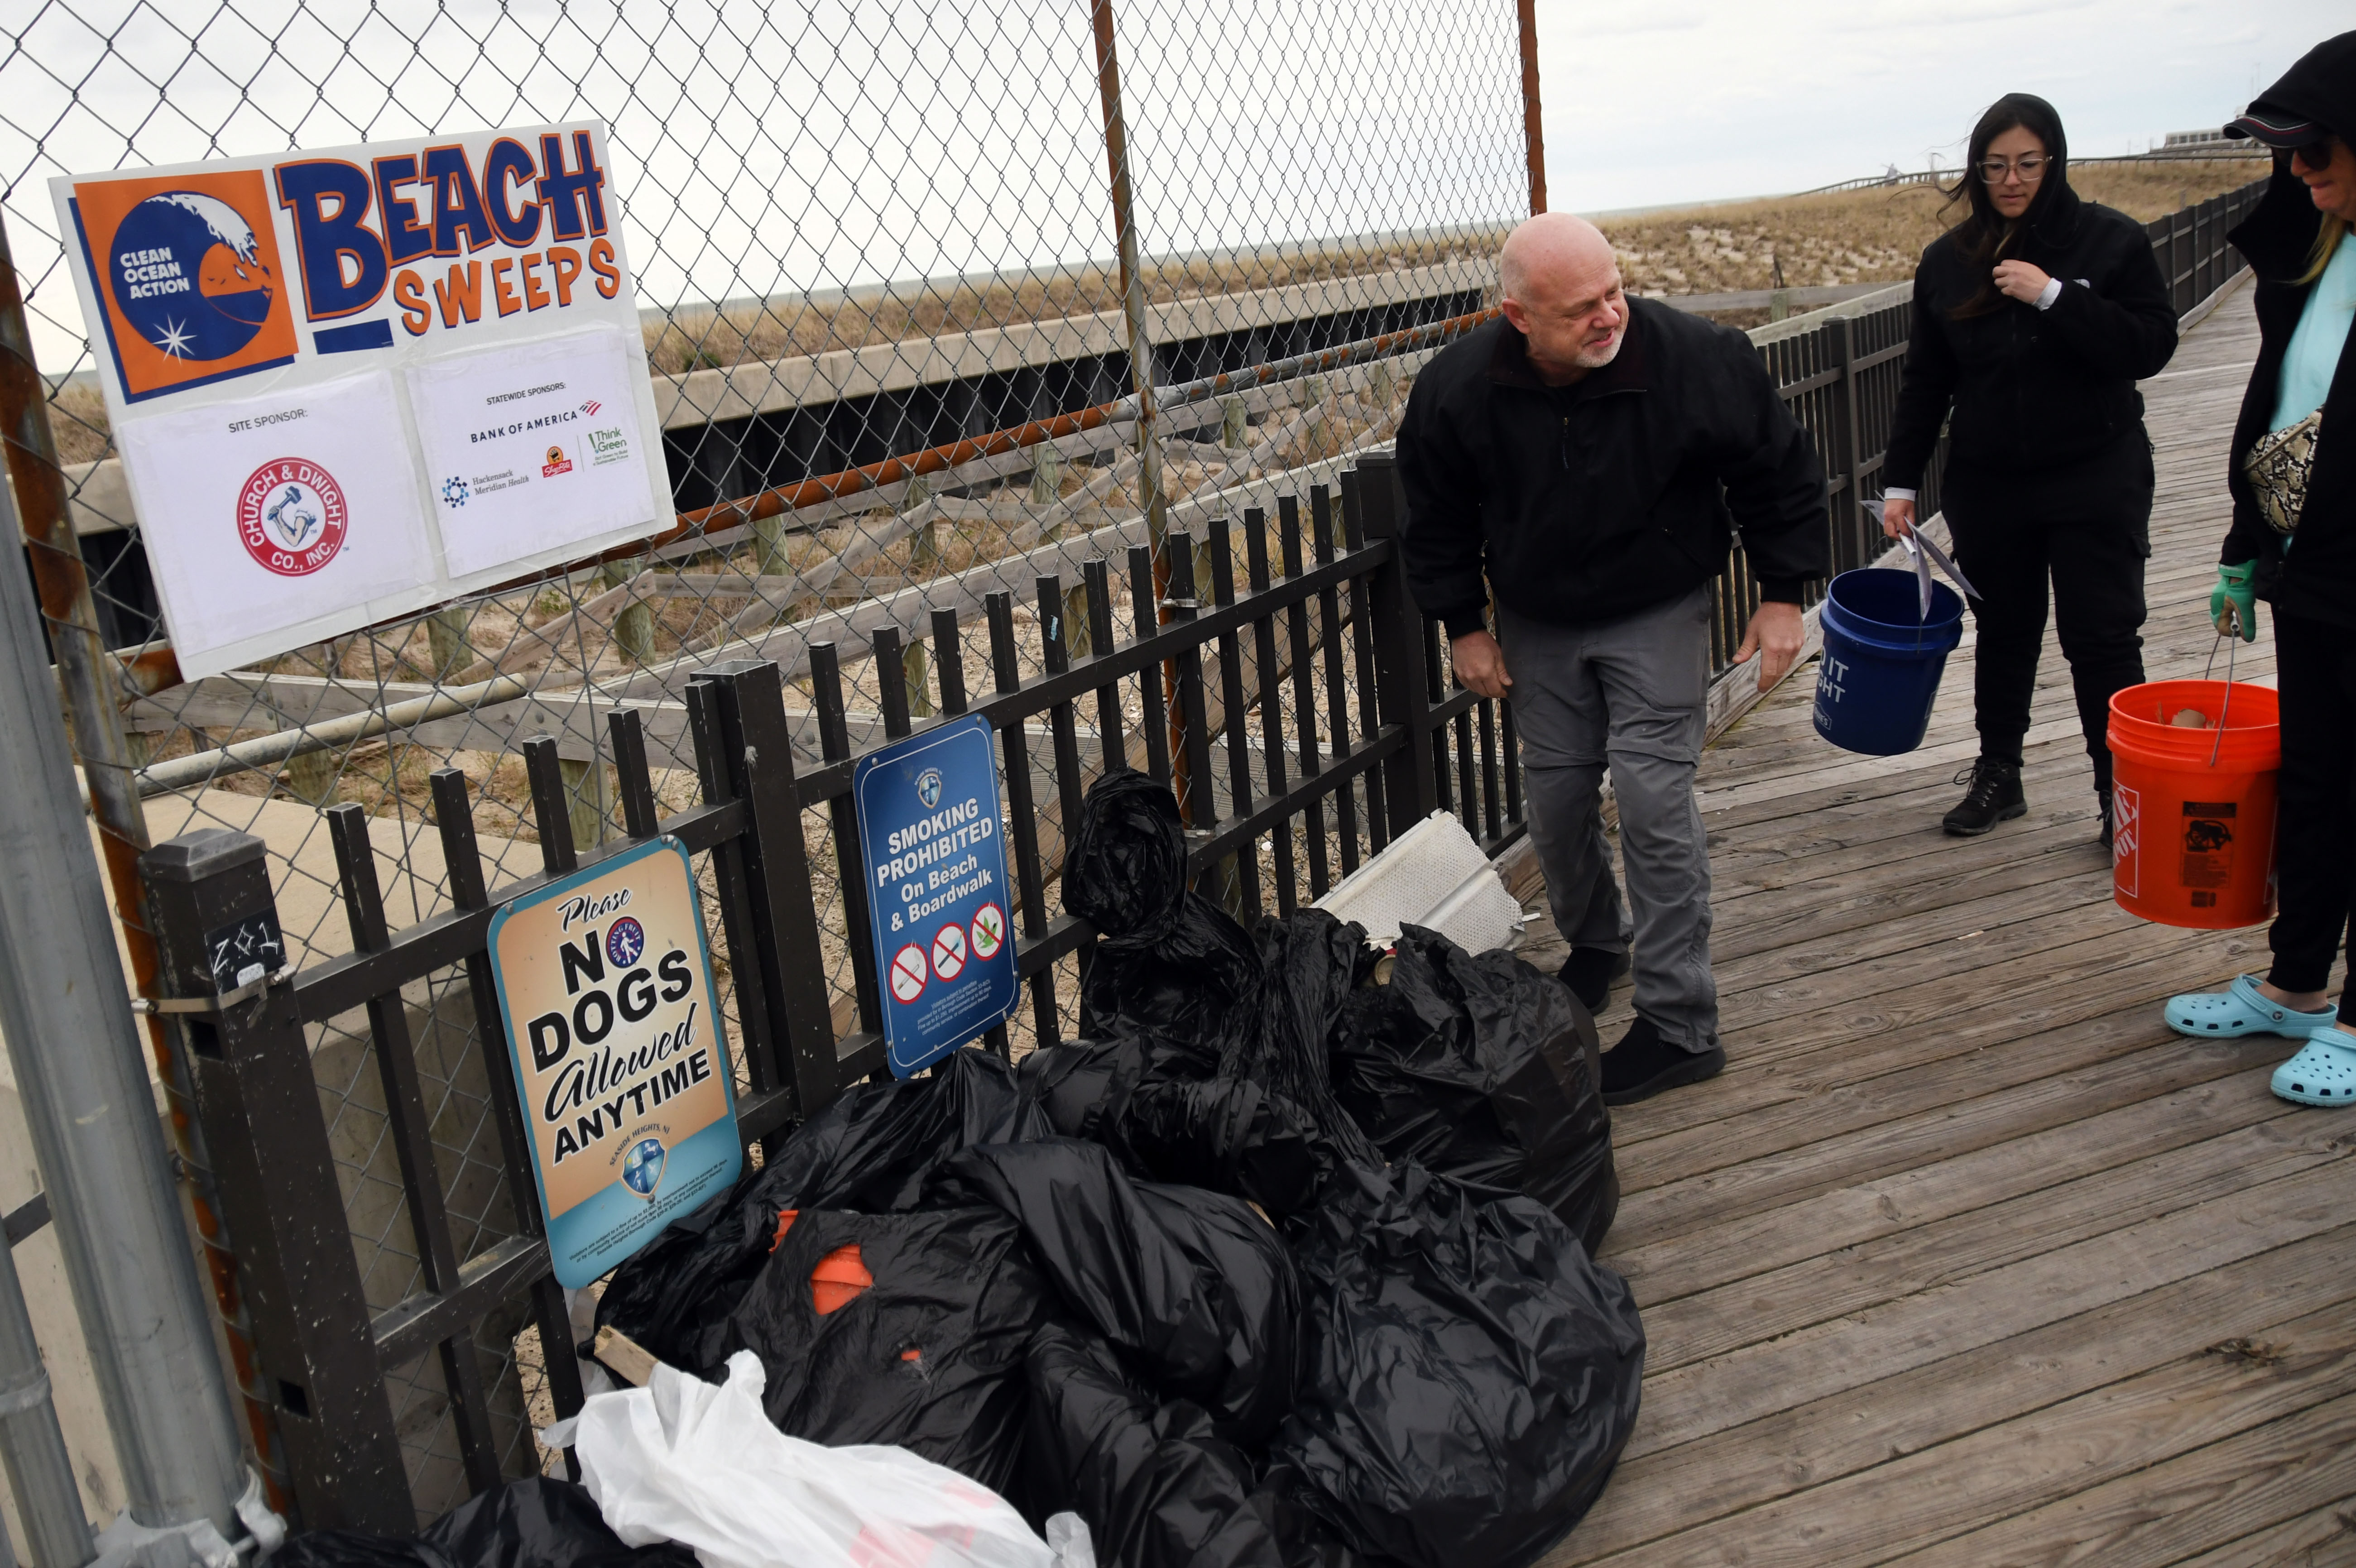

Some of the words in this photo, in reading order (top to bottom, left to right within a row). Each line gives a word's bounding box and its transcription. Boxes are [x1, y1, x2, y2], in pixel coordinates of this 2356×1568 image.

[273, 130, 608, 322] BEACH
[120, 247, 172, 267] CLEAN
[124, 262, 181, 283] OCEAN
[130, 278, 190, 299] ACTION
[394, 238, 620, 336] SWEEPS
[487, 390, 526, 405] STATEWIDE
[528, 382, 566, 396] SPONSORS:
[229, 419, 252, 433] SITE
[254, 409, 308, 427] SPONSOR:
[471, 427, 505, 443] BANK
[509, 423, 523, 434] OF
[527, 411, 577, 431] AMERICA
[595, 427, 622, 441] Think
[598, 440, 627, 452] Green
[472, 470, 513, 485] Hackensack
[475, 483, 506, 495] Meridian
[508, 475, 529, 487] Health
[244, 470, 278, 547] CHURCH
[281, 465, 293, 480] &
[298, 466, 341, 529] DWIGHT
[306, 542, 335, 566] INC.
[1818, 669, 1846, 703] GHT
[1828, 657, 1849, 682] IT
[888, 797, 978, 855] SMOKING
[877, 817, 993, 887] PROHIBITED
[901, 881, 923, 903] On
[928, 854, 978, 891] Beach
[558, 889, 630, 931] Please
[891, 912, 904, 932] &
[908, 869, 993, 924] Boardwalk
[528, 950, 692, 1073] DOGS
[554, 1049, 711, 1167] ANYTIME
[609, 1135, 631, 1166] SEASIDE
[632, 1123, 661, 1138] HEIGHTS,
[663, 1125, 670, 1134] NJ
